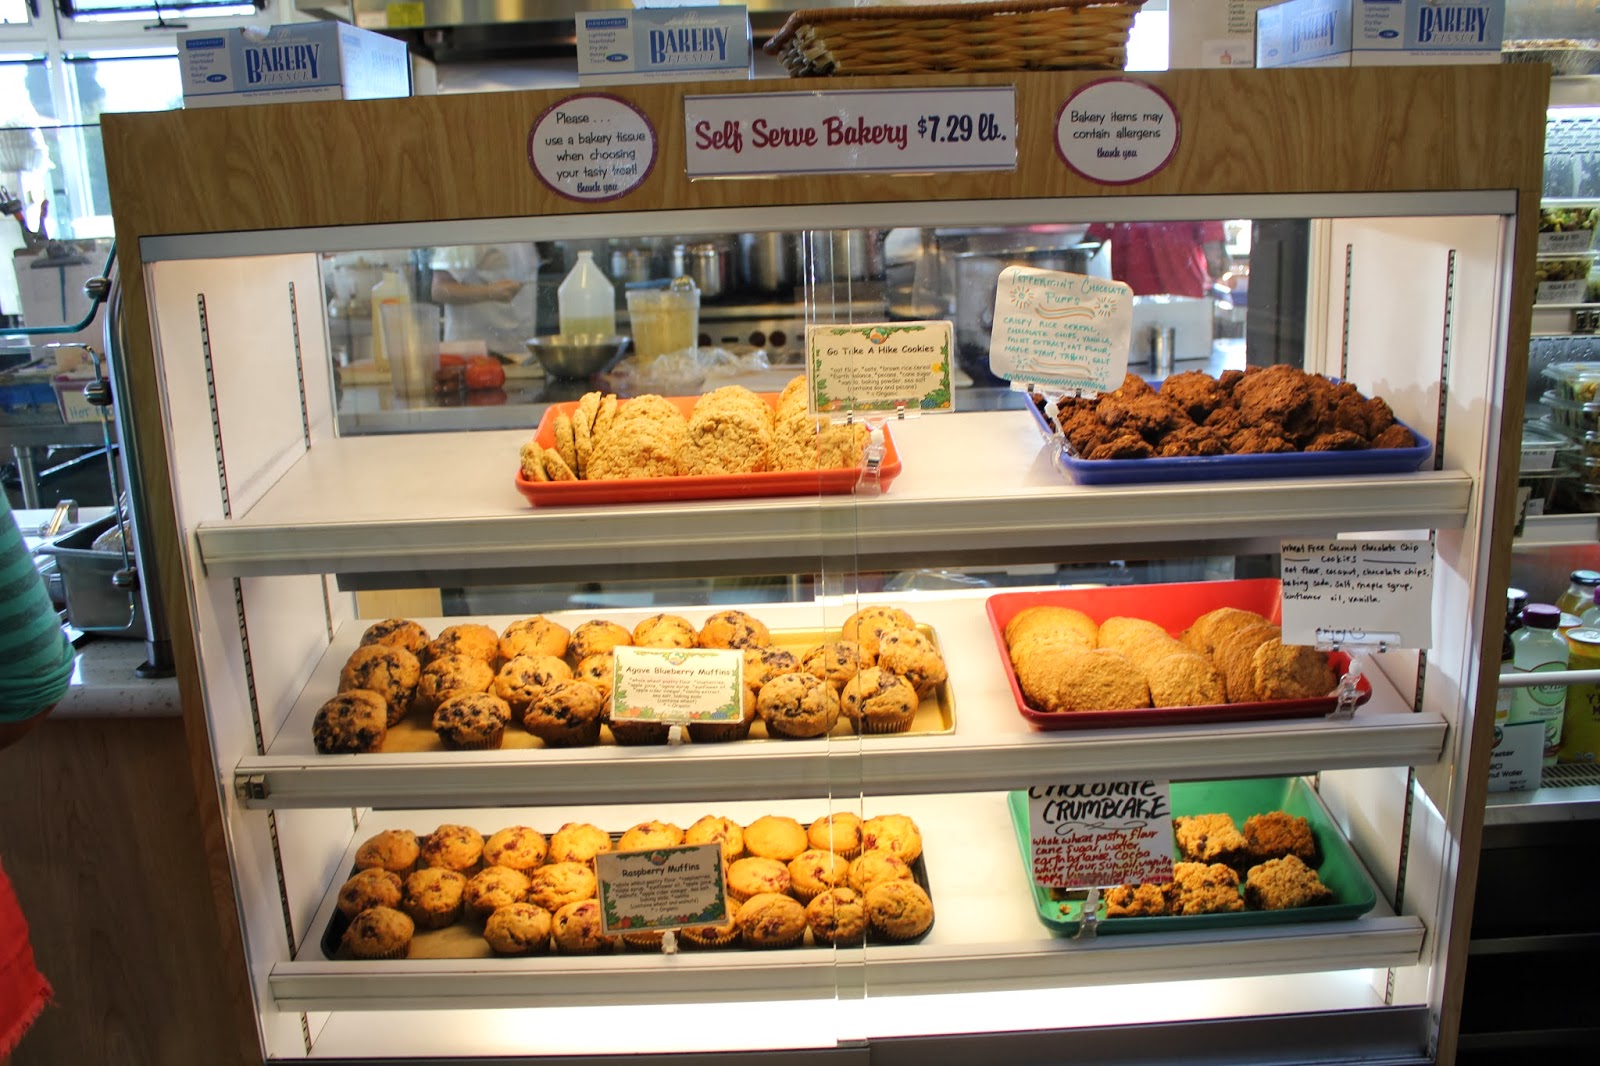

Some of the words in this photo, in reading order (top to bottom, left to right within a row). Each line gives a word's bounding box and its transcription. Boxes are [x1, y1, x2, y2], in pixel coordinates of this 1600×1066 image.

[1418, 6, 1490, 43] BAKERY
[650, 26, 729, 64] BAKERY
[245, 43, 320, 84] BAKERY
[556, 111, 590, 124] Please
[1070, 110, 1106, 125] Bakery
[1110, 111, 1138, 122] items
[1143, 112, 1164, 125] may
[545, 136, 563, 147] use
[568, 136, 574, 145] a
[578, 132, 612, 146] bakery
[616, 131, 646, 143] tissue
[695, 120, 743, 154] Self
[751, 118, 819, 149] Serve
[822, 115, 908, 151] Bakery
[917, 114, 973, 143] $7.29
[977, 113, 1007, 141] lb.
[1073, 128, 1110, 139] contain
[1116, 127, 1161, 140] allergens
[556, 149, 584, 161] when
[590, 148, 636, 161] choosing
[1096, 147, 1120, 158] thank
[1122, 149, 1138, 160] you
[556, 168, 579, 181] your
[583, 166, 608, 180] tasty
[577, 181, 601, 193] thank
[603, 183, 619, 194] you
[1003, 316, 1033, 328] CRISPY
[1039, 320, 1057, 328] RICE
[826, 347, 838, 356] Go
[867, 346, 875, 354] A
[878, 345, 898, 354] Hike
[901, 344, 935, 354] Cookies
[1307, 544, 1325, 553] Free
[1329, 543, 1357, 552] Coconut
[1361, 544, 1396, 552] Chocolate
[1400, 543, 1419, 554] Chip
[1321, 555, 1357, 564] Cookies
[1362, 567, 1401, 576] chocolate
[1404, 567, 1430, 578] chips,
[1281, 578, 1309, 592] baking
[1356, 581, 1383, 591] maple
[1387, 583, 1413, 593] syrup,
[625, 666, 651, 675] Agave
[654, 667, 695, 676] Blueberry
[698, 668, 731, 676] Muffins
[1043, 795, 1171, 824] CRUMBCAKE
[622, 867, 665, 878] Raspberry
[667, 863, 700, 874] Muffins
